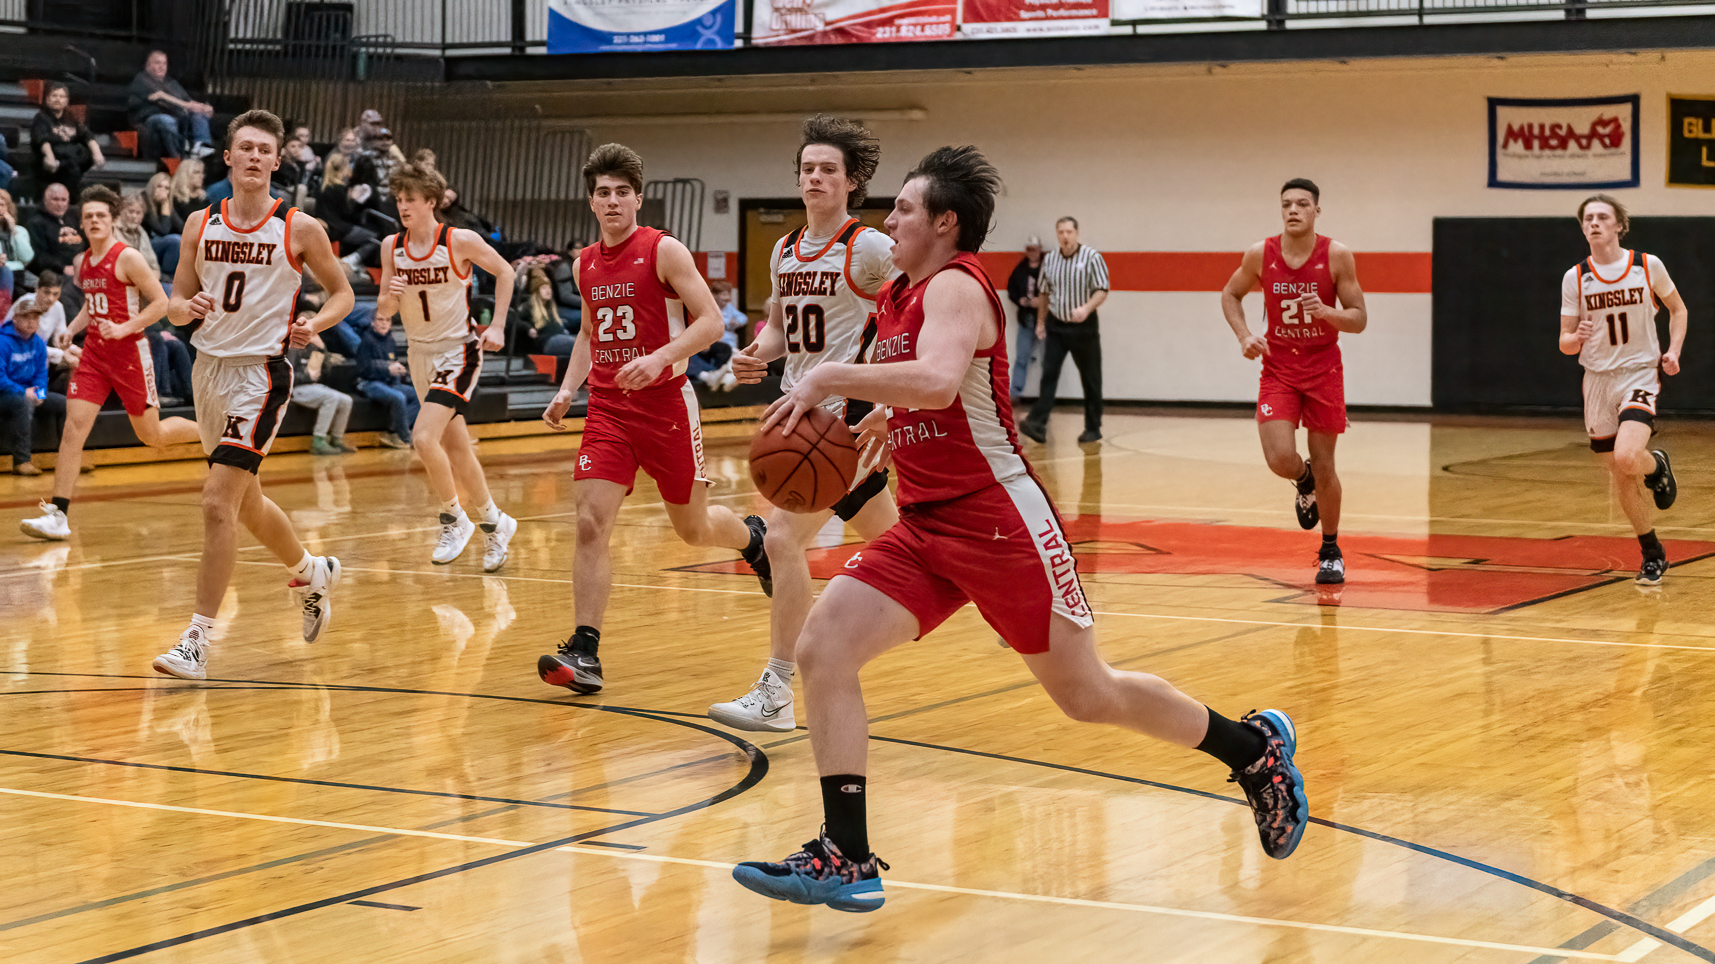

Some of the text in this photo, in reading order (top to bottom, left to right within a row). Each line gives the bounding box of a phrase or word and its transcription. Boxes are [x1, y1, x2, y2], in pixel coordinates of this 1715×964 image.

[1502, 114, 1624, 151] MHSAA
[1682, 117, 1715, 139] GL
[204, 239, 278, 266] KINGSLEY
[222, 271, 246, 313] 0
[591, 282, 635, 301] BENZIE
[1273, 282, 1318, 294] BENZIE
[1585, 287, 1644, 311] KINGSLEY
[418, 290, 431, 322] 1
[596, 304, 637, 342] 23
[785, 304, 825, 354] 20
[1275, 326, 1325, 339] CENTRAL
[1606, 311, 1629, 346] 11
[876, 332, 911, 362] BENZIE
[1629, 389, 1654, 408] K
[221, 414, 249, 441] K
